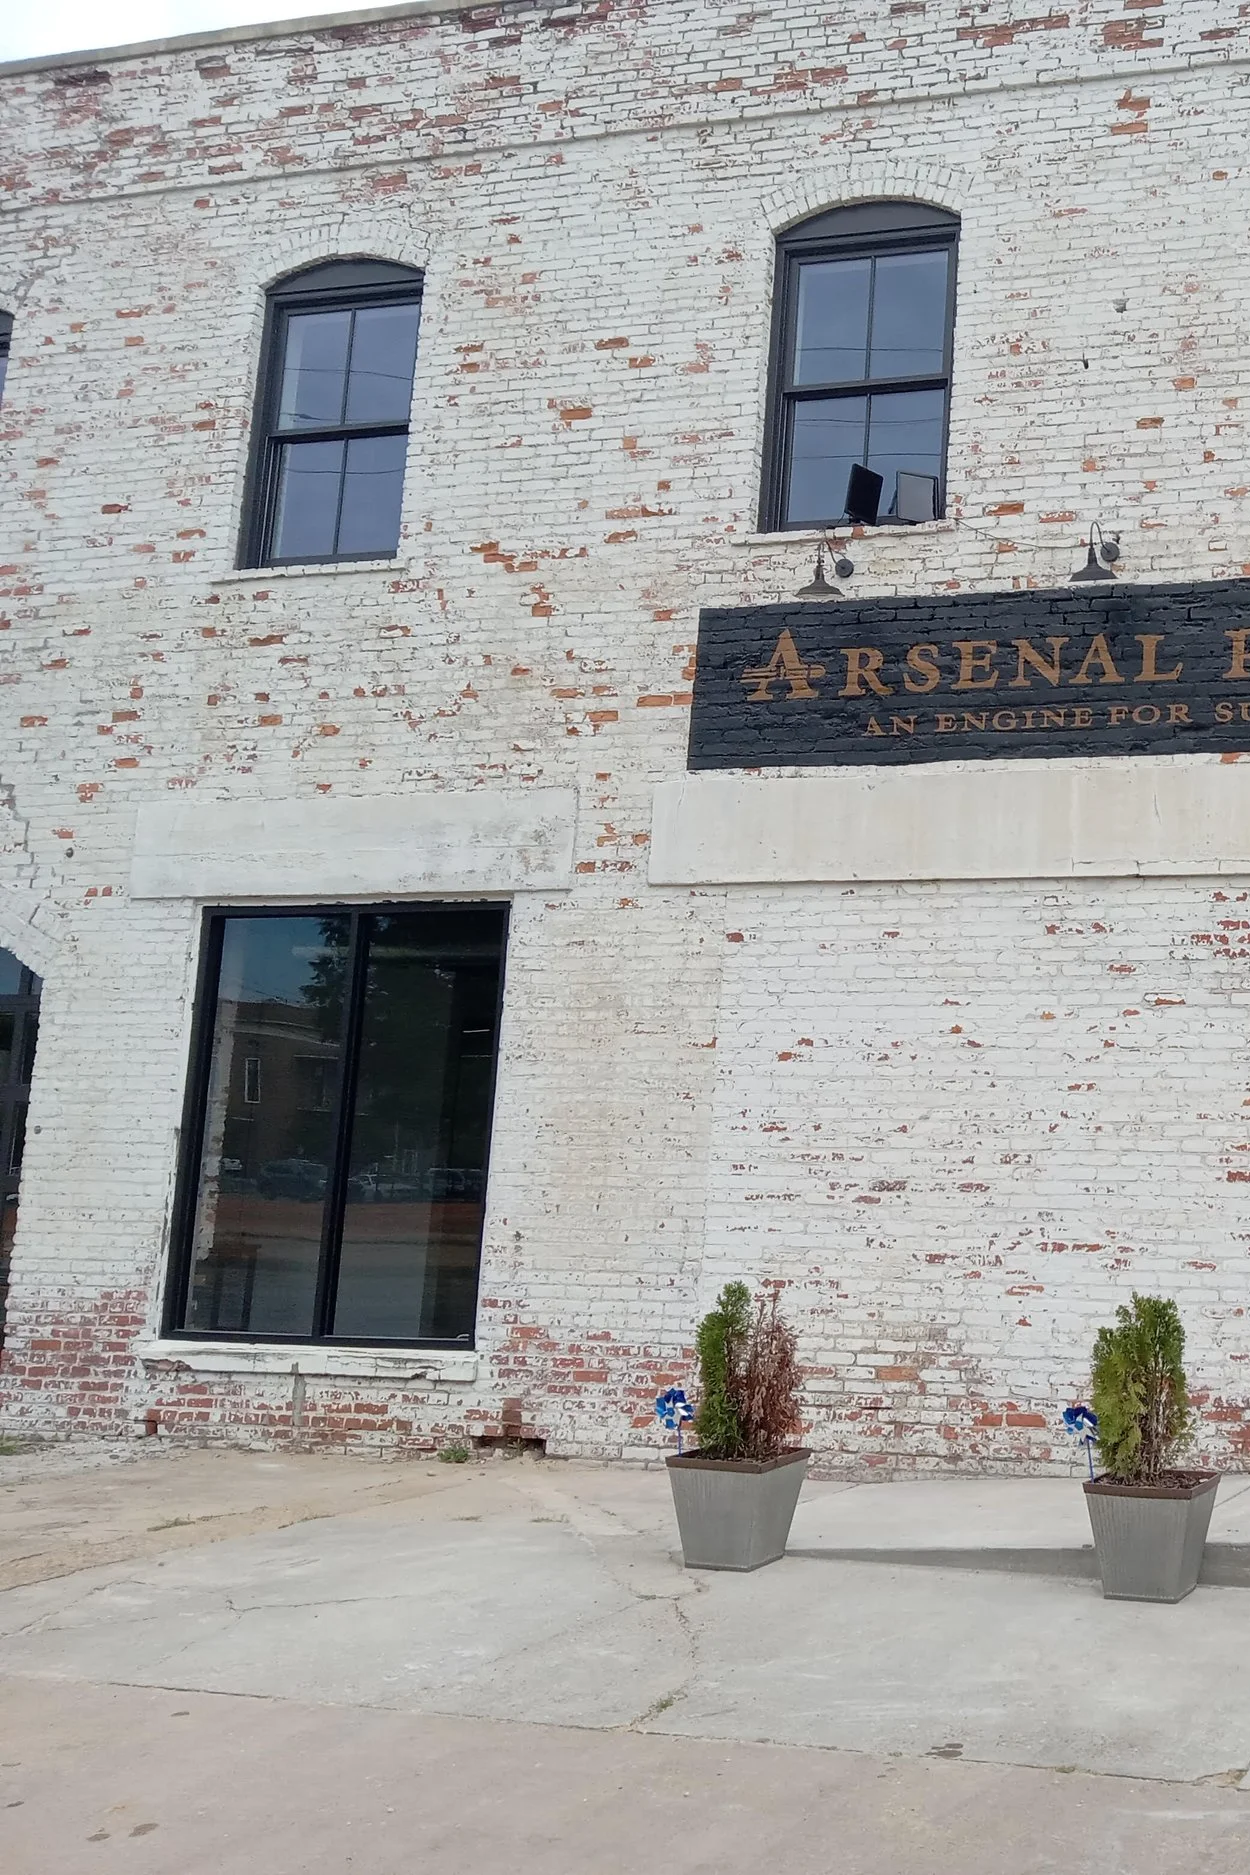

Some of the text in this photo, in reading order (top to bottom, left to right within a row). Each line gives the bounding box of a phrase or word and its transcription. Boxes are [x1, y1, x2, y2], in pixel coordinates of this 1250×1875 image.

[740, 628, 1184, 701] ARSENAL
[861, 716, 917, 738] AN
[934, 707, 1093, 733] ENGINE
[1110, 702, 1193, 726] FOR
